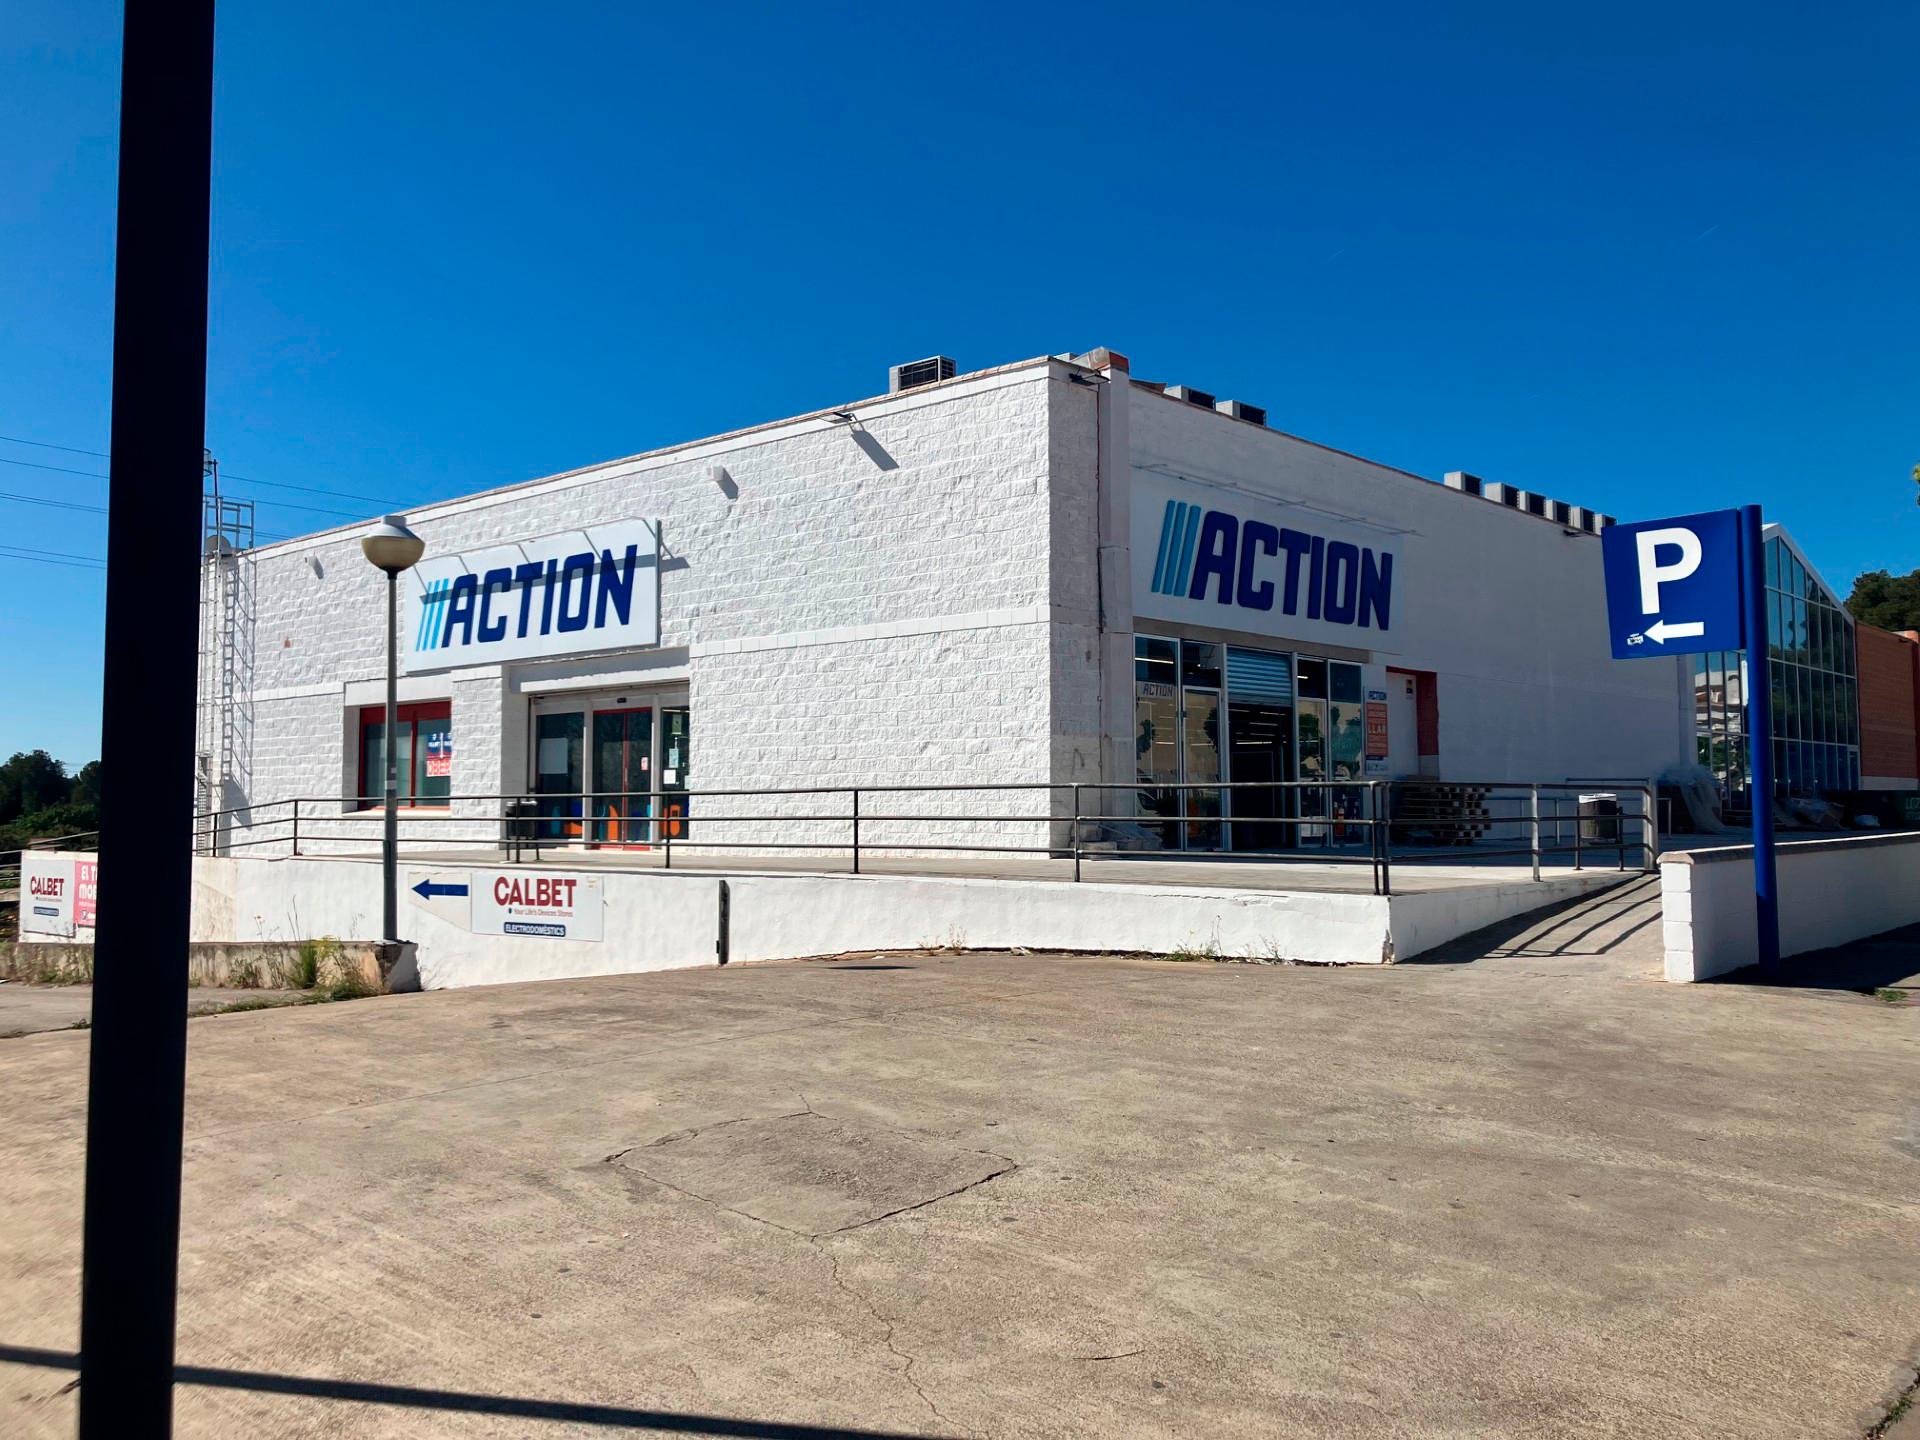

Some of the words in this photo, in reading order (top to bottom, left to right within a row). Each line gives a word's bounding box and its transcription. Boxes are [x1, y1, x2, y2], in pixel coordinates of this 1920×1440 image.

[441, 544, 638, 648] ACTION
[1189, 510, 1393, 631] ACTION
[1636, 527, 1702, 615] P
[1143, 683, 1173, 697] ACTION
[31, 876, 64, 896] CALBET
[494, 876, 577, 908] CALBET
